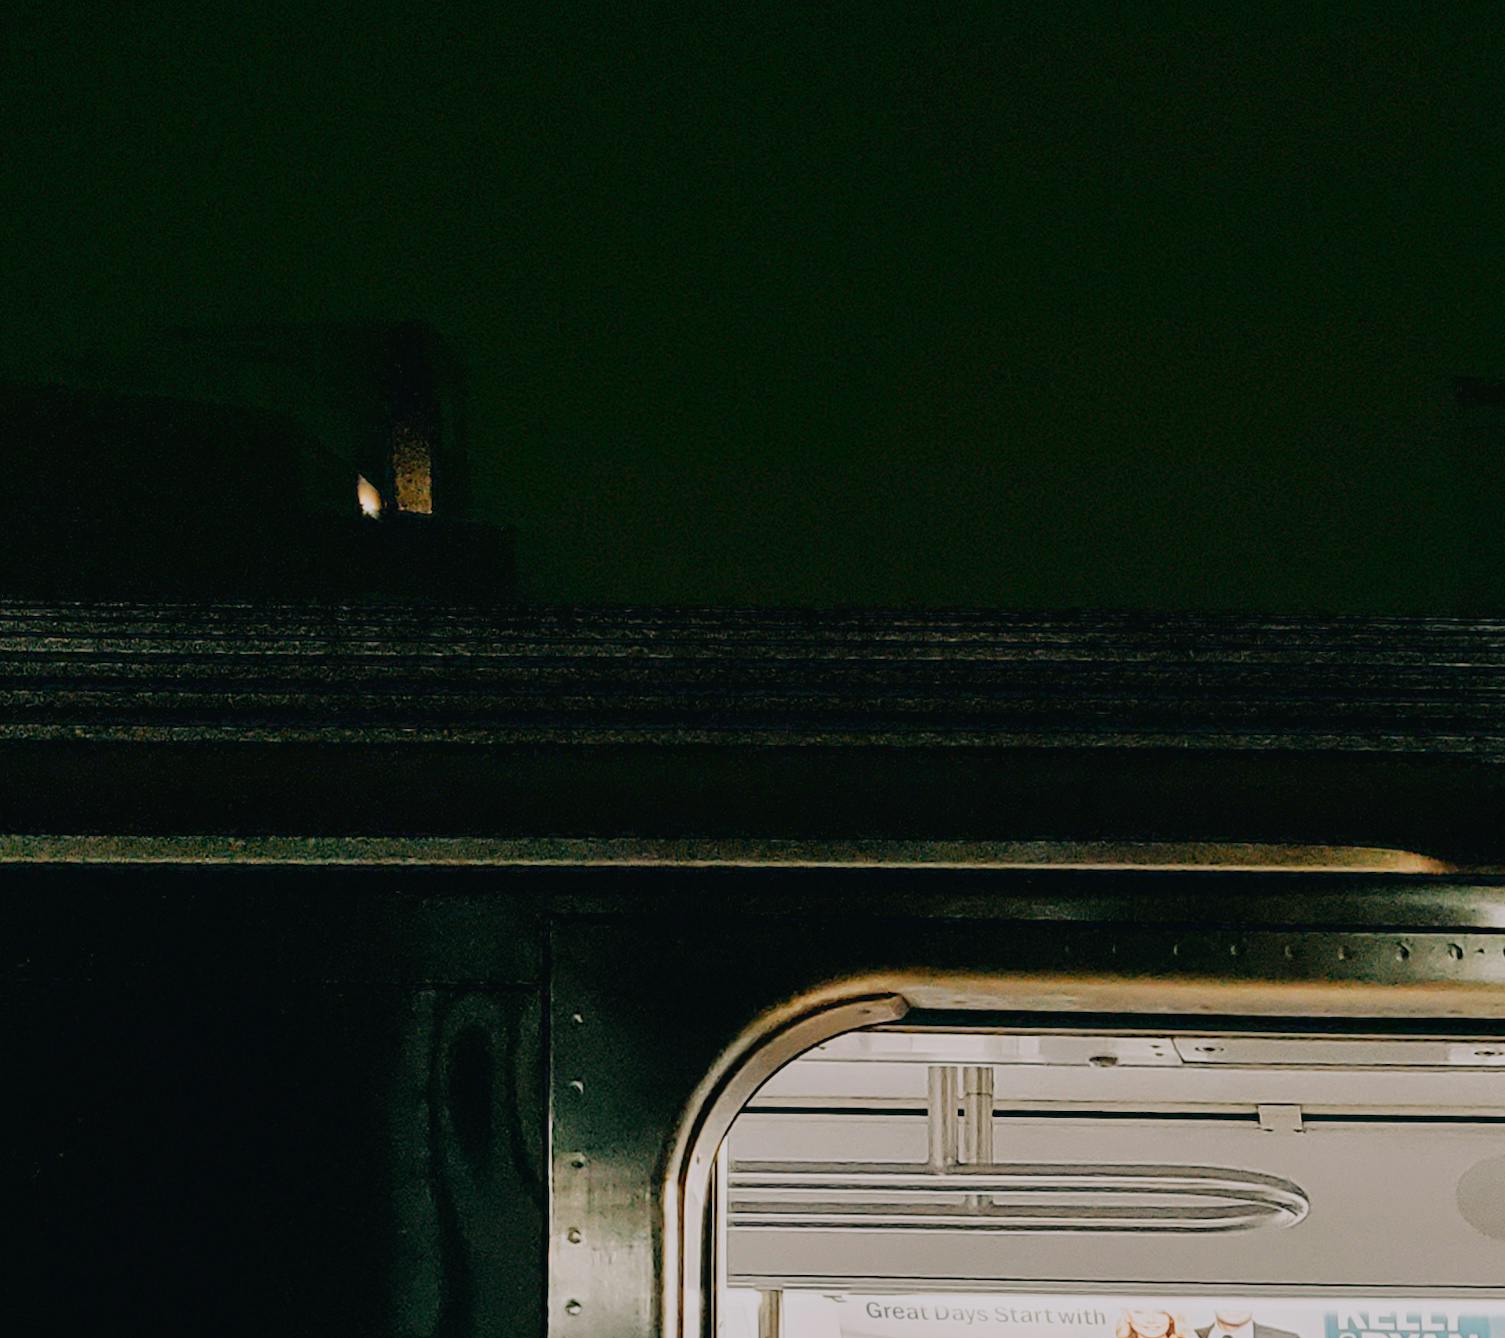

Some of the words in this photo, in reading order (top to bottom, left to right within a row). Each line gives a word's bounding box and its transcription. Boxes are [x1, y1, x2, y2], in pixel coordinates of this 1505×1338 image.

[865, 1301, 929, 1321] Great
[935, 1306, 989, 1325] Days
[994, 1306, 1054, 1324] Start
[1058, 1309, 1107, 1326] with
